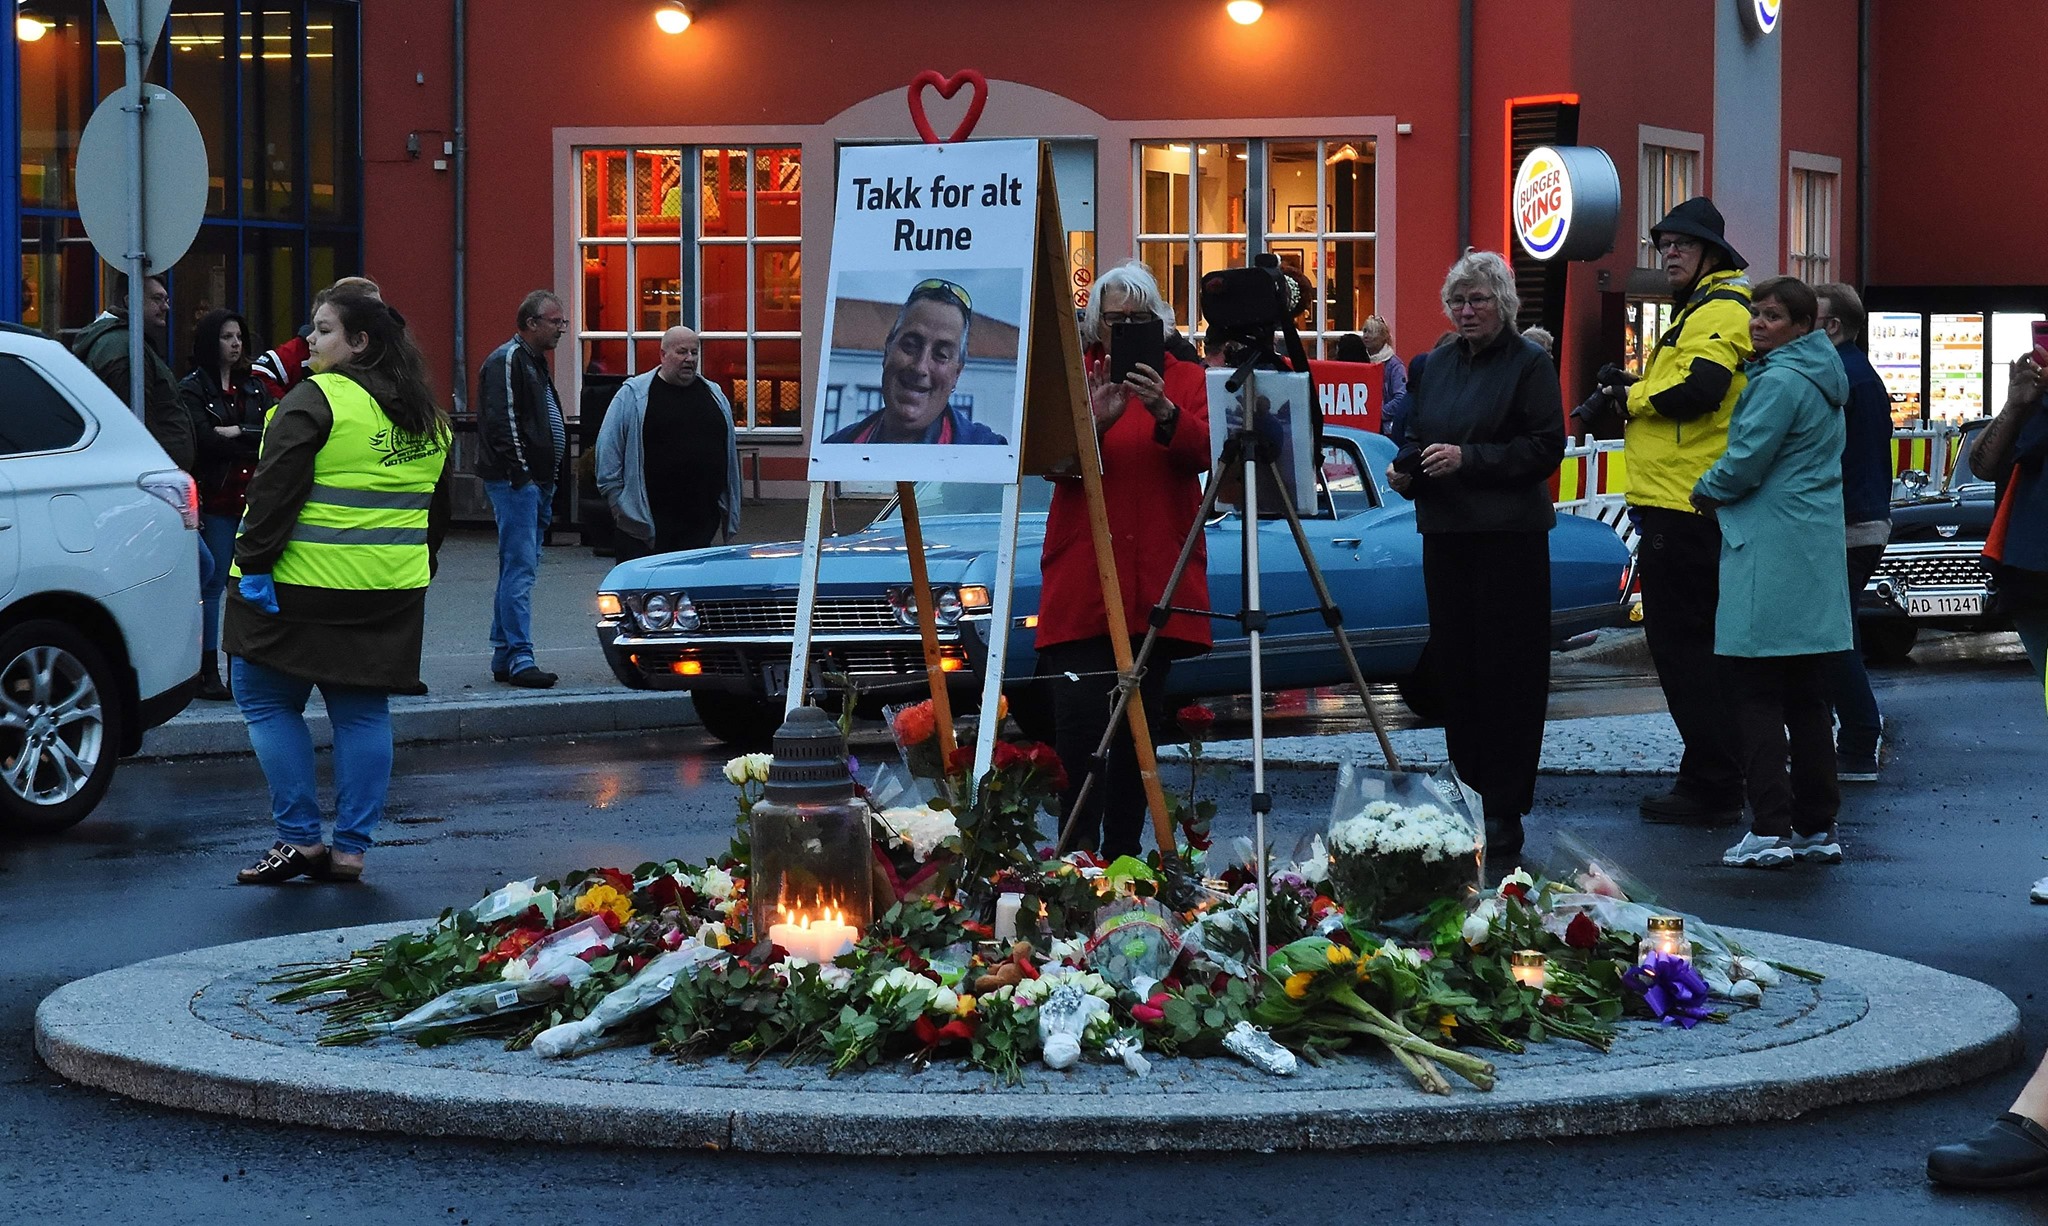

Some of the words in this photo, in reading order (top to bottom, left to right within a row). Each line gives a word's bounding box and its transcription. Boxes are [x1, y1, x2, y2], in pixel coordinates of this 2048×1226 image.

[852, 176, 922, 211] Takk
[930, 174, 975, 209] for
[981, 172, 1023, 208] alt
[1520, 169, 1560, 209] BURGER
[1522, 186, 1561, 234] KING
[893, 218, 972, 252] Rune
[1318, 383, 1368, 416] HAR
[1911, 598, 1931, 613] AD
[1938, 597, 1978, 613] 11241
